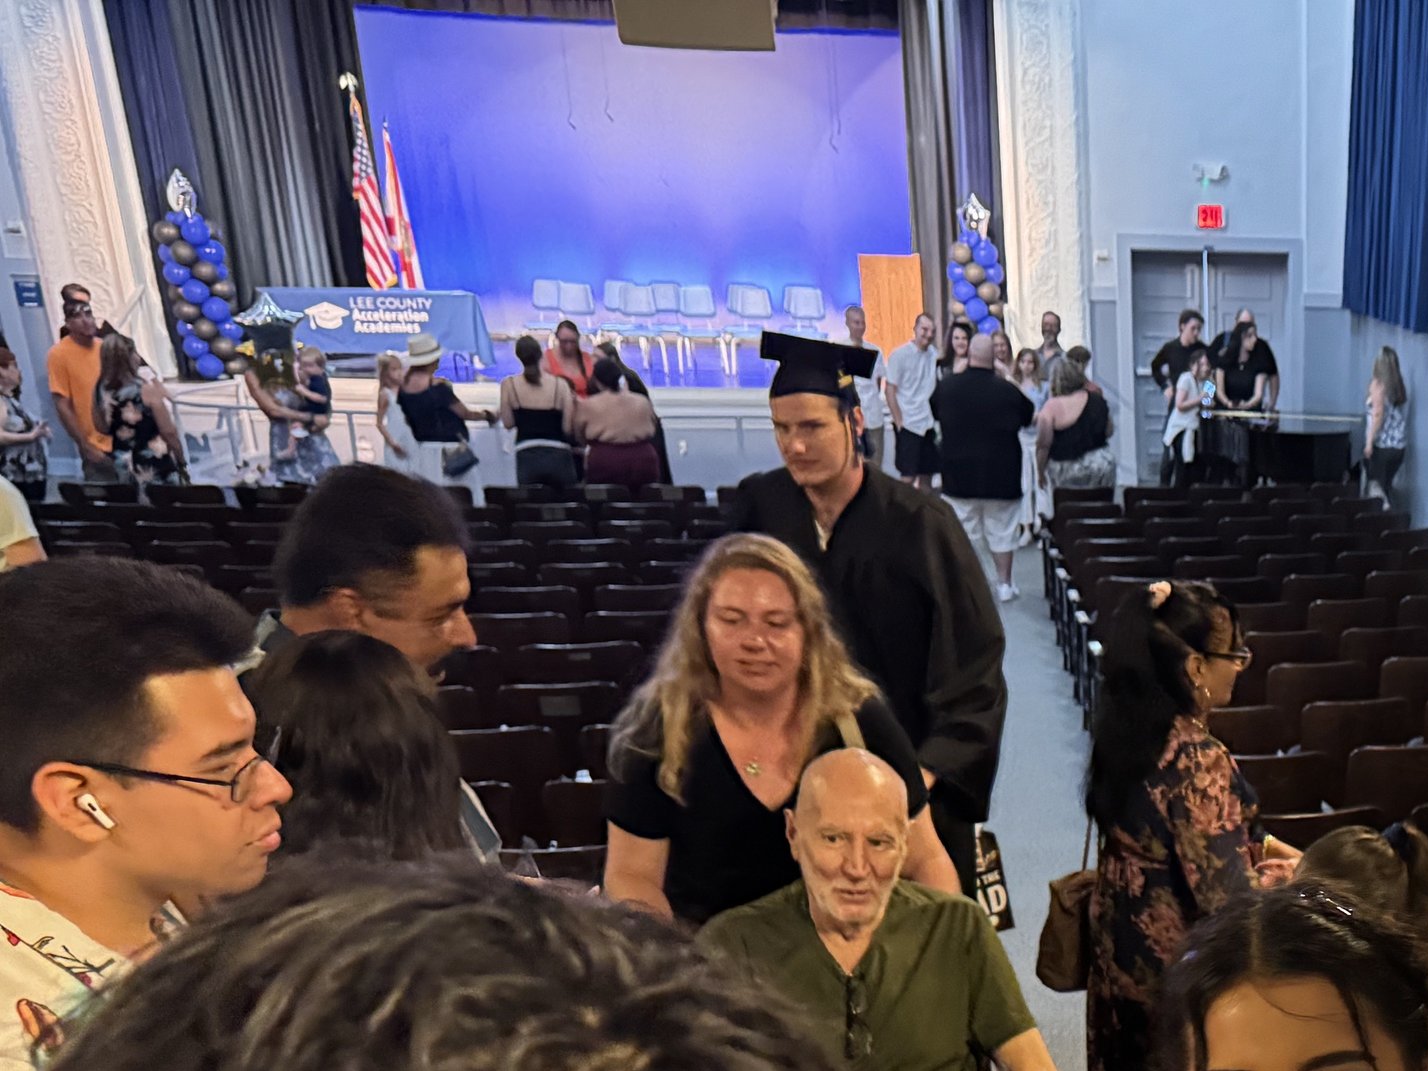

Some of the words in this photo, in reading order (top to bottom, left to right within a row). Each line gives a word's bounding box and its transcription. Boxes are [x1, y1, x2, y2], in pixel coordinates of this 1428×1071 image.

[349, 297, 375, 309] LEE
[376, 297, 432, 310] COUNTY
[352, 308, 429, 322] Acceleration
[354, 321, 421, 334] Academies
